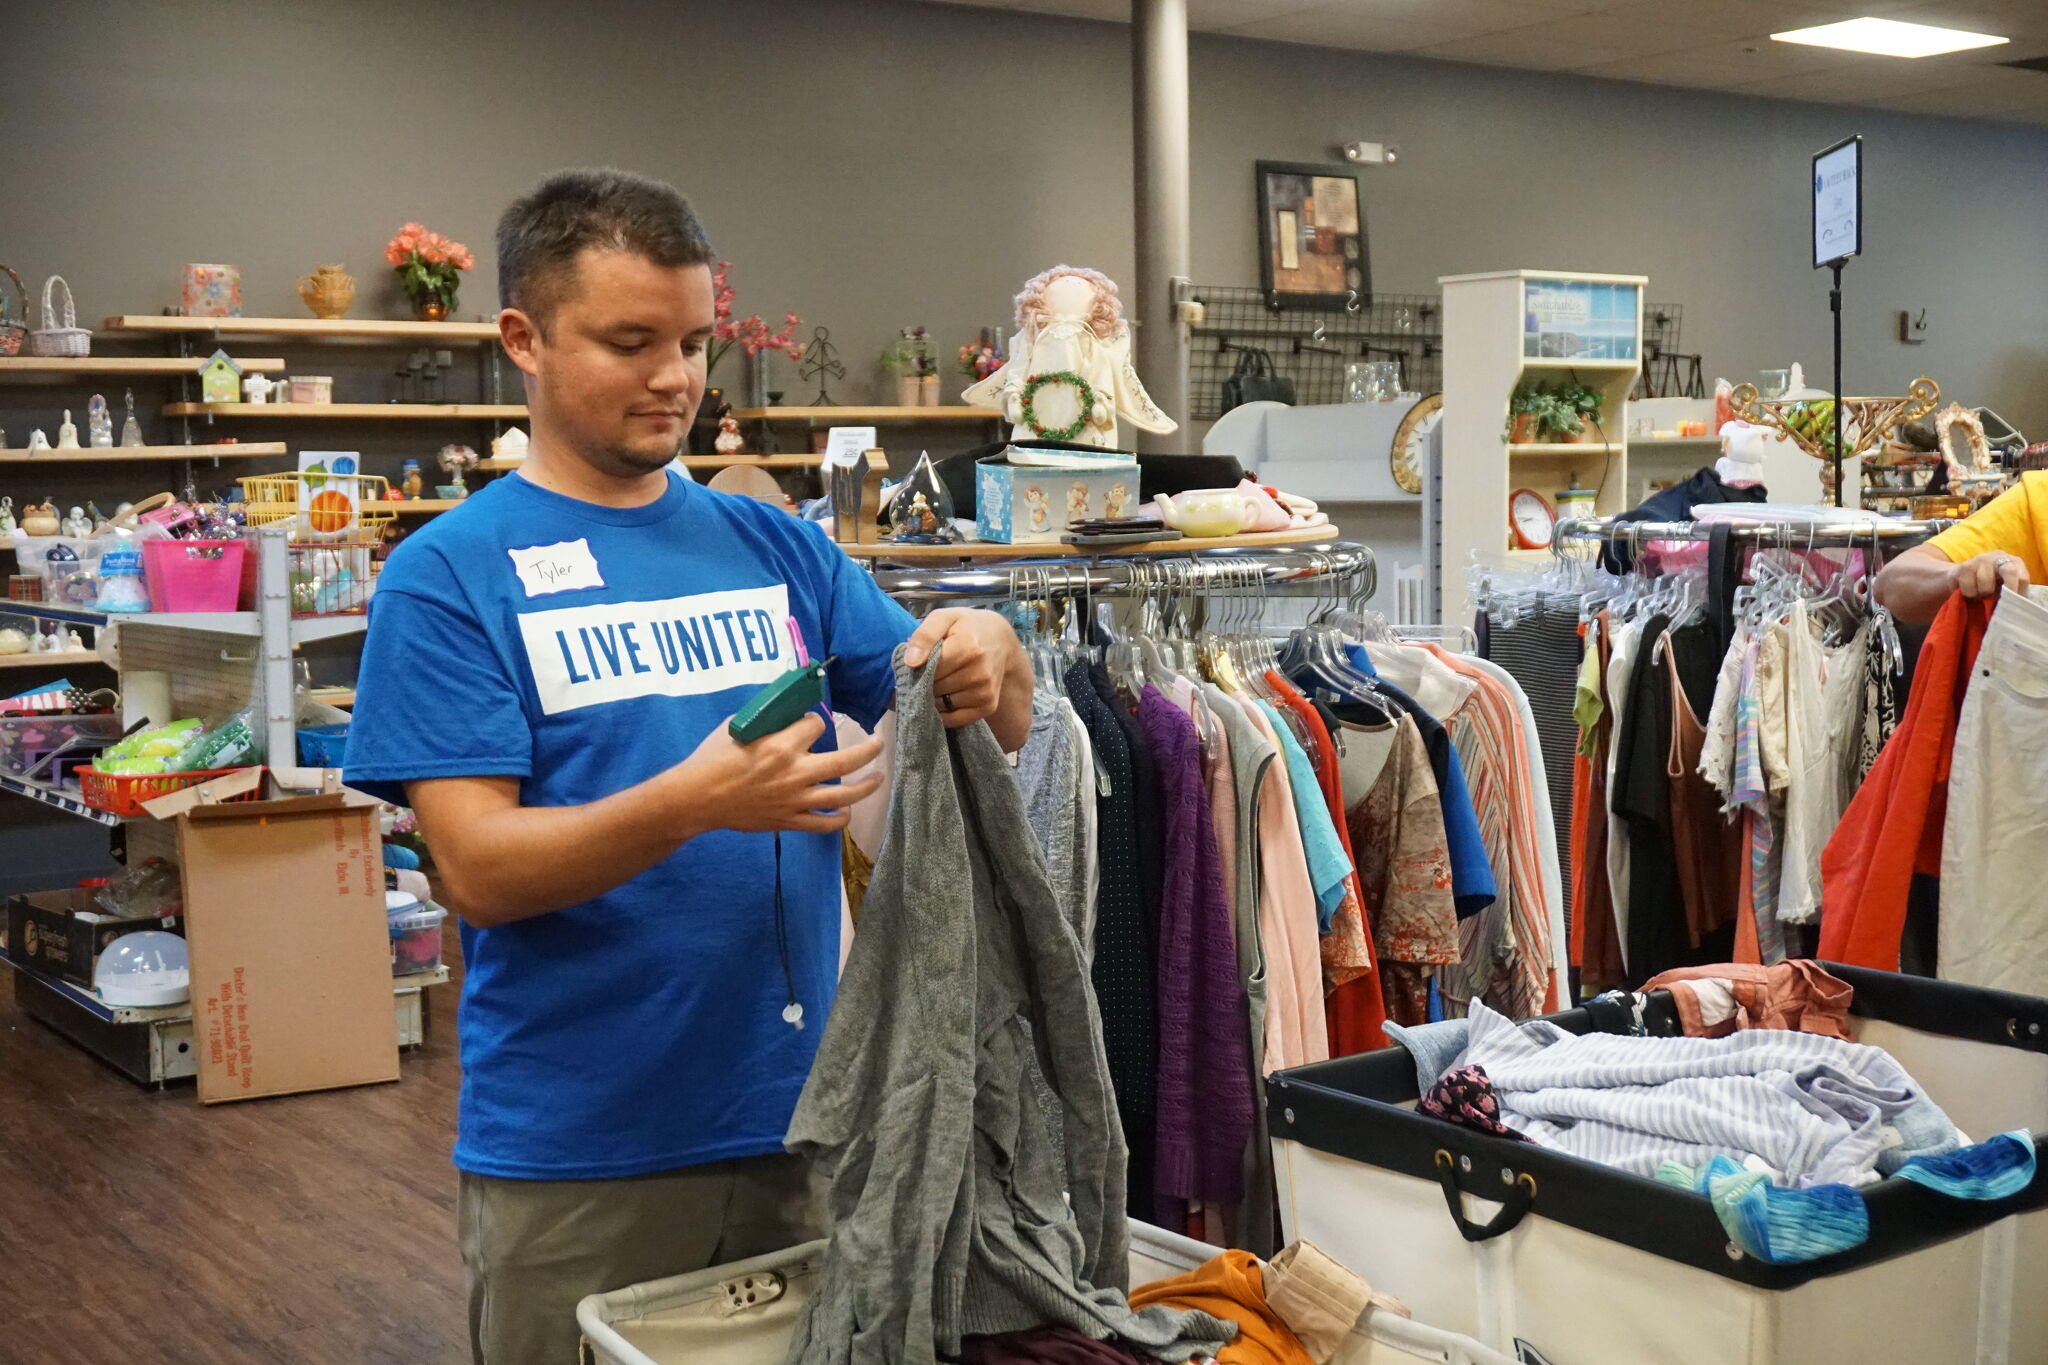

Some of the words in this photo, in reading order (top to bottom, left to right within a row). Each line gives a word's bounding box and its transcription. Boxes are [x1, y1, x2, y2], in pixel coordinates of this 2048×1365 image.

[529, 560, 573, 584] Tyler
[555, 621, 651, 684] LIVE
[650, 608, 779, 675] UNITED
[221, 982, 232, 1001] With
[222, 1005, 235, 1050] Detachable
[226, 1052, 239, 1077] Stand
